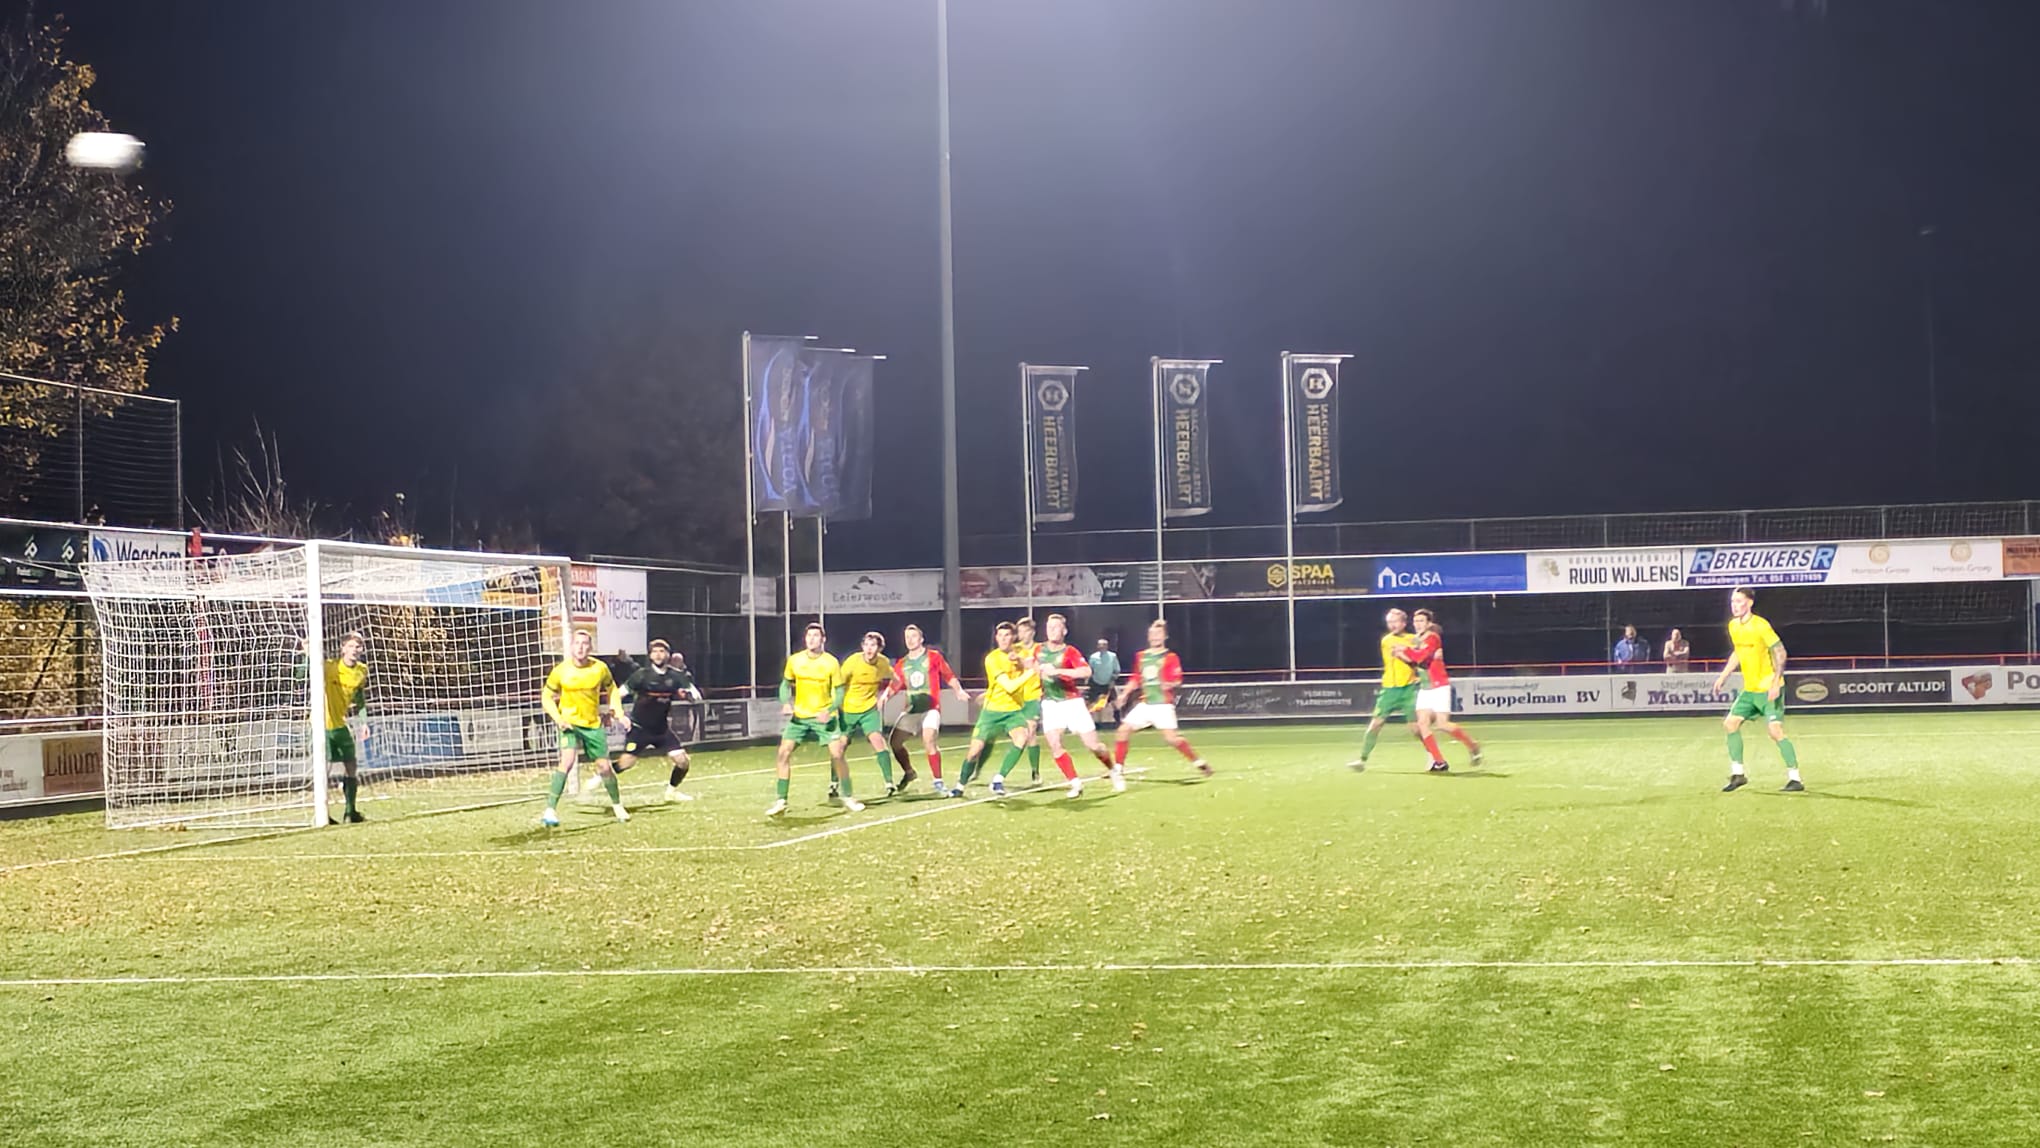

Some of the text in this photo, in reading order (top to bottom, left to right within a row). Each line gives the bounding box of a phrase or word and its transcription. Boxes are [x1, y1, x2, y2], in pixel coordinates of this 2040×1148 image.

[1175, 408, 1192, 504] HEERBAART
[1307, 404, 1323, 500] HEERBAART
[1043, 415, 1060, 509] HEERBAART
[1714, 549, 1812, 570] BREUKERS
[1292, 564, 1335, 579] SPAA
[1398, 572, 1442, 587] CASA
[1569, 565, 1679, 584] RUUD WIJLENS
[1103, 579, 1126, 589] RTT
[1838, 681, 1894, 695] SCOORT
[1897, 680, 1946, 693] ALTIJD!
[1474, 690, 1600, 708] Koppelman BV
